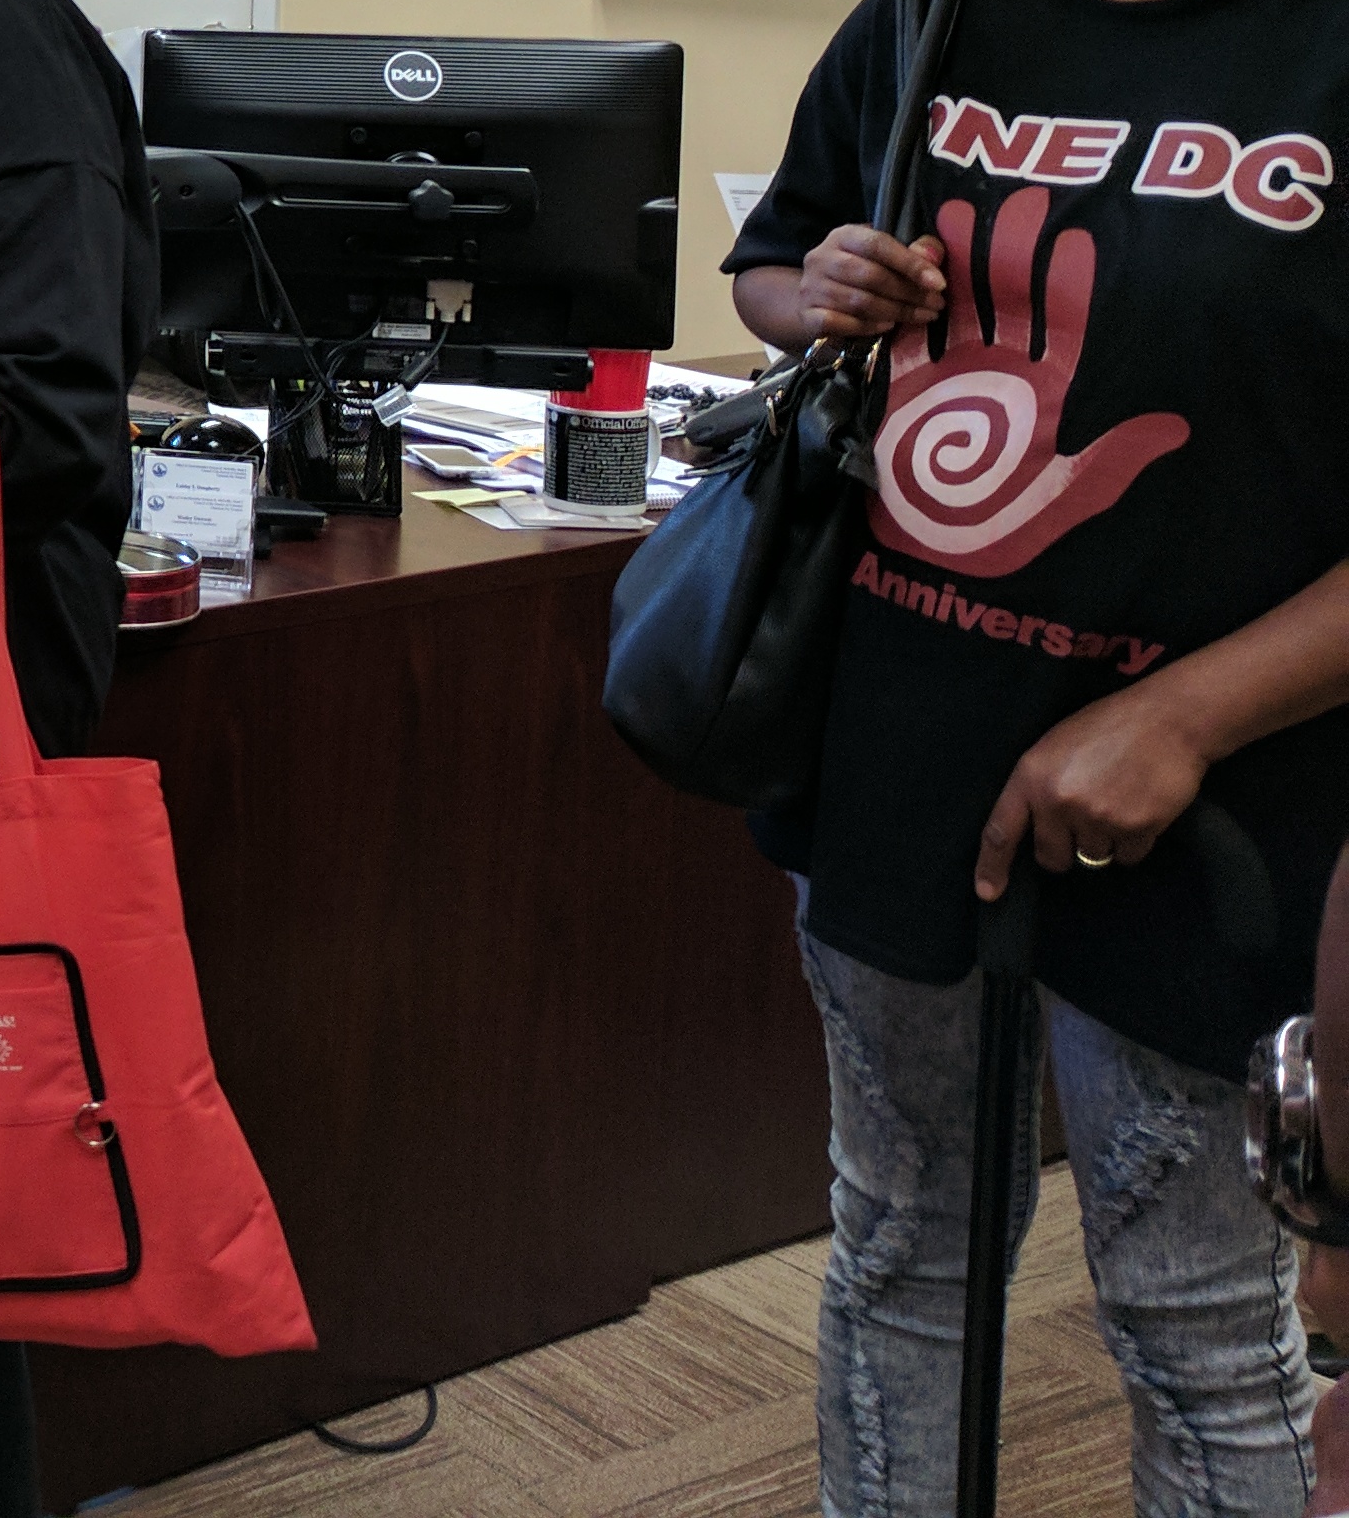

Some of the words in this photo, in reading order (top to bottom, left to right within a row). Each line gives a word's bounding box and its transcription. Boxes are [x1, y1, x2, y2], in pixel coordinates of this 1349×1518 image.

[390, 68, 437, 83] DELL
[1132, 121, 1334, 232] DC
[850, 550, 1166, 677] Anniversary
